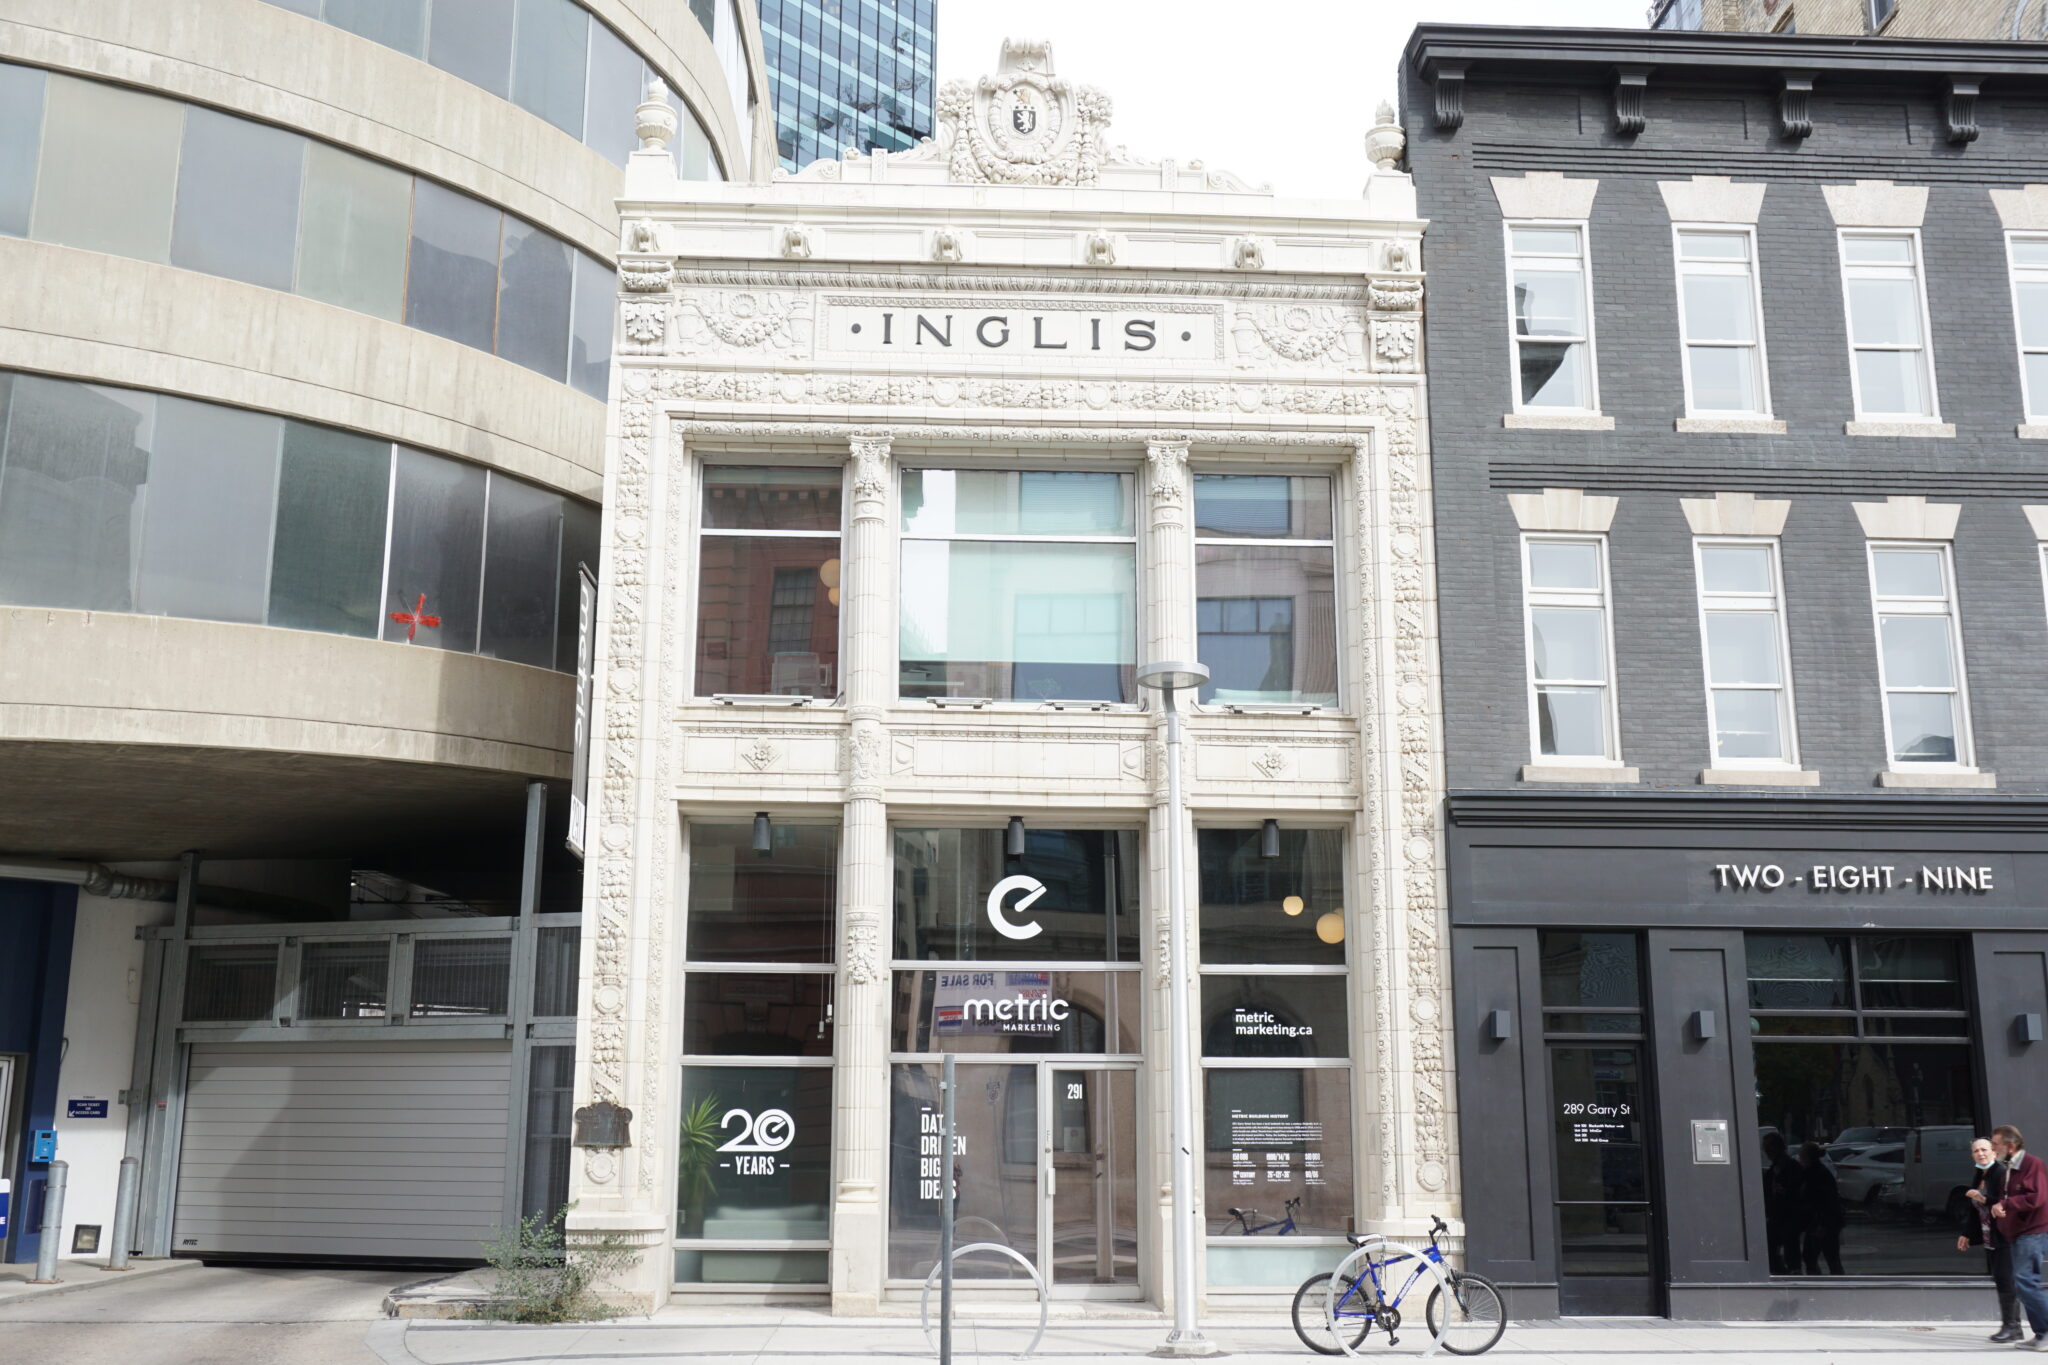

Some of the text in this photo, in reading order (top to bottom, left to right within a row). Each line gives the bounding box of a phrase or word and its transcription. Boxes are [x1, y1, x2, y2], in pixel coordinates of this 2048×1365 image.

[882, 313, 1157, 351] INGLIS
[574, 584, 590, 748] metric
[1716, 864, 1785, 888] TWO
[1813, 865, 1895, 889] EIGHT
[1923, 865, 1994, 890] NINE
[963, 993, 1069, 1021] metric
[1235, 1011, 1275, 1023] metric
[1003, 1023, 1061, 1032] MARKETING
[1235, 1023, 1313, 1038] marketing.ca
[1067, 1083, 1083, 1100] 291
[1563, 1103, 1631, 1118] 289 Garry St
[921, 1135, 967, 1156] DRIEN
[735, 1155, 775, 1176] YEARS
[920, 1157, 941, 1178] BIG
